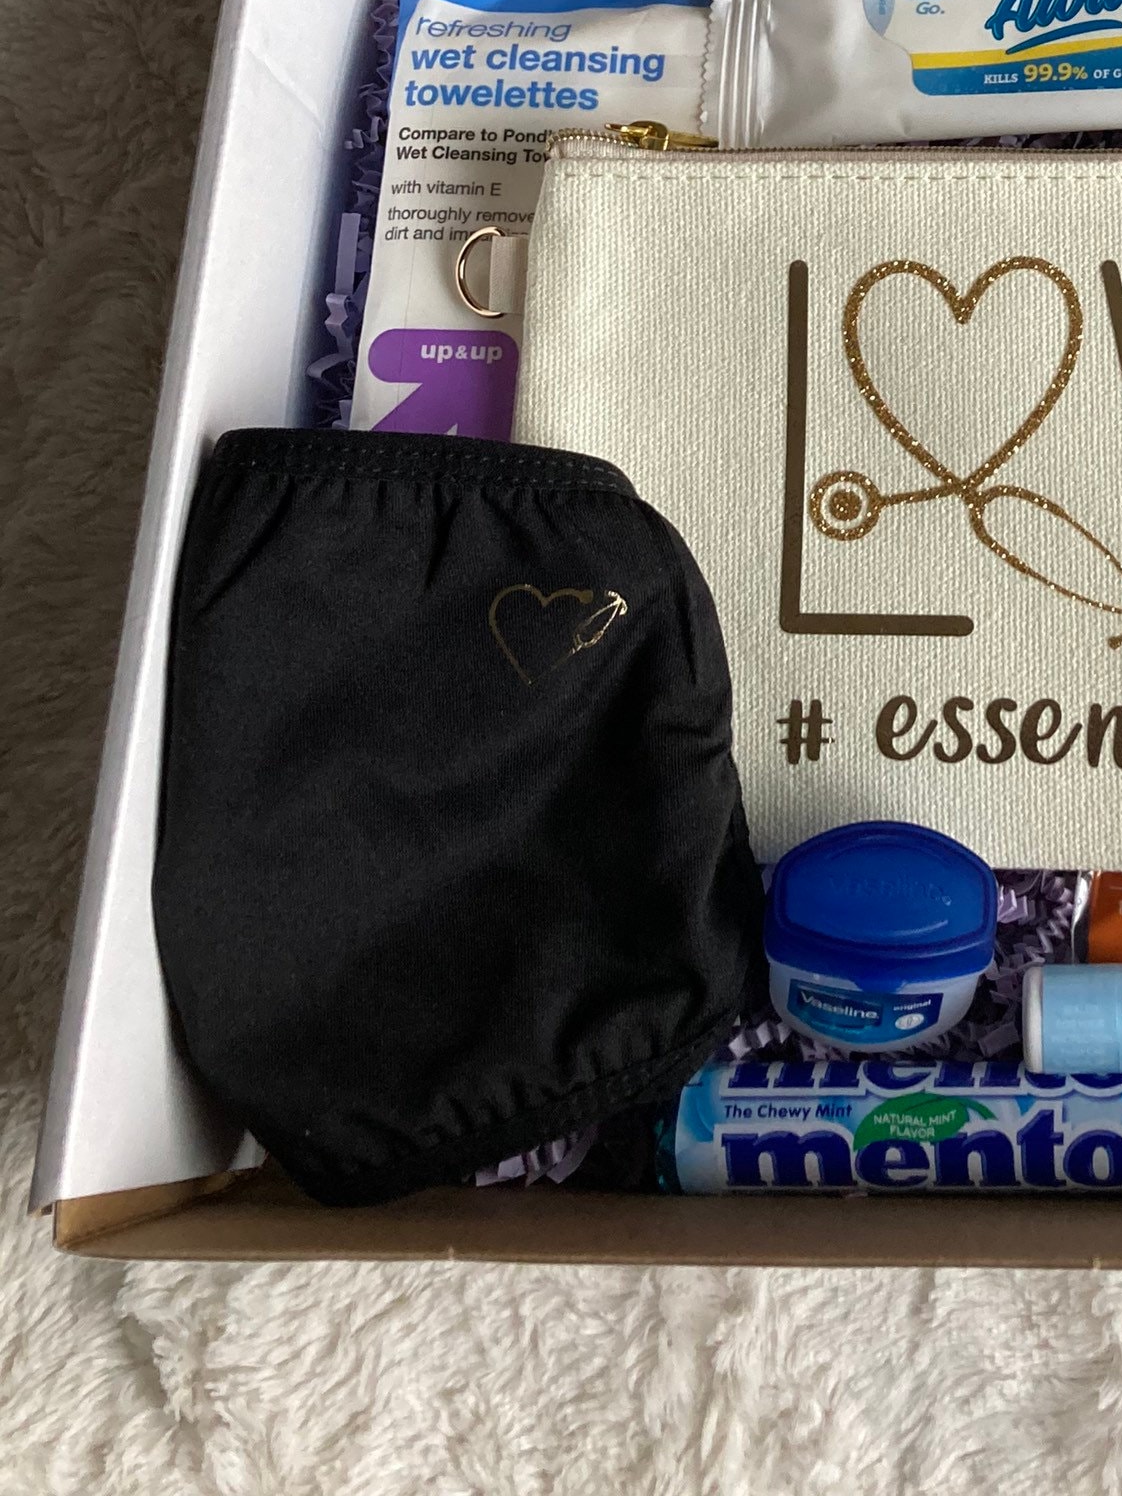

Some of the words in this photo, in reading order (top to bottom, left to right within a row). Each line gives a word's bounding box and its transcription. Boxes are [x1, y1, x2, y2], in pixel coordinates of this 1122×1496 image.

[915, 2, 946, 15] Go.
[414, 16, 573, 42] refreshing
[411, 45, 476, 70] wet
[486, 44, 666, 82] cleansing
[984, 72, 1018, 85] KILLS
[1023, 62, 1088, 84] 99.9%
[1093, 67, 1109, 80] OF
[404, 79, 600, 110] towelettes
[398, 126, 475, 143] Compare
[481, 129, 497, 142] to
[396, 146, 427, 160] Wet
[432, 146, 517, 165] Cleansing
[391, 180, 421, 195] with
[427, 181, 484, 196] vitamin
[490, 182, 503, 197] E
[387, 206, 472, 223] thoroughly
[385, 226, 409, 241] dirt
[413, 227, 444, 241] and
[421, 344, 503, 364] up&up
[800, 990, 880, 1020] Vaseline
[725, 1104, 753, 1120] The
[756, 1105, 813, 1122] Chewy
[816, 1104, 853, 1119] Mint
[873, 1112, 928, 1129] NATURAL
[929, 1110, 957, 1126] MINT
[889, 1125, 936, 1140] FLAVOR
